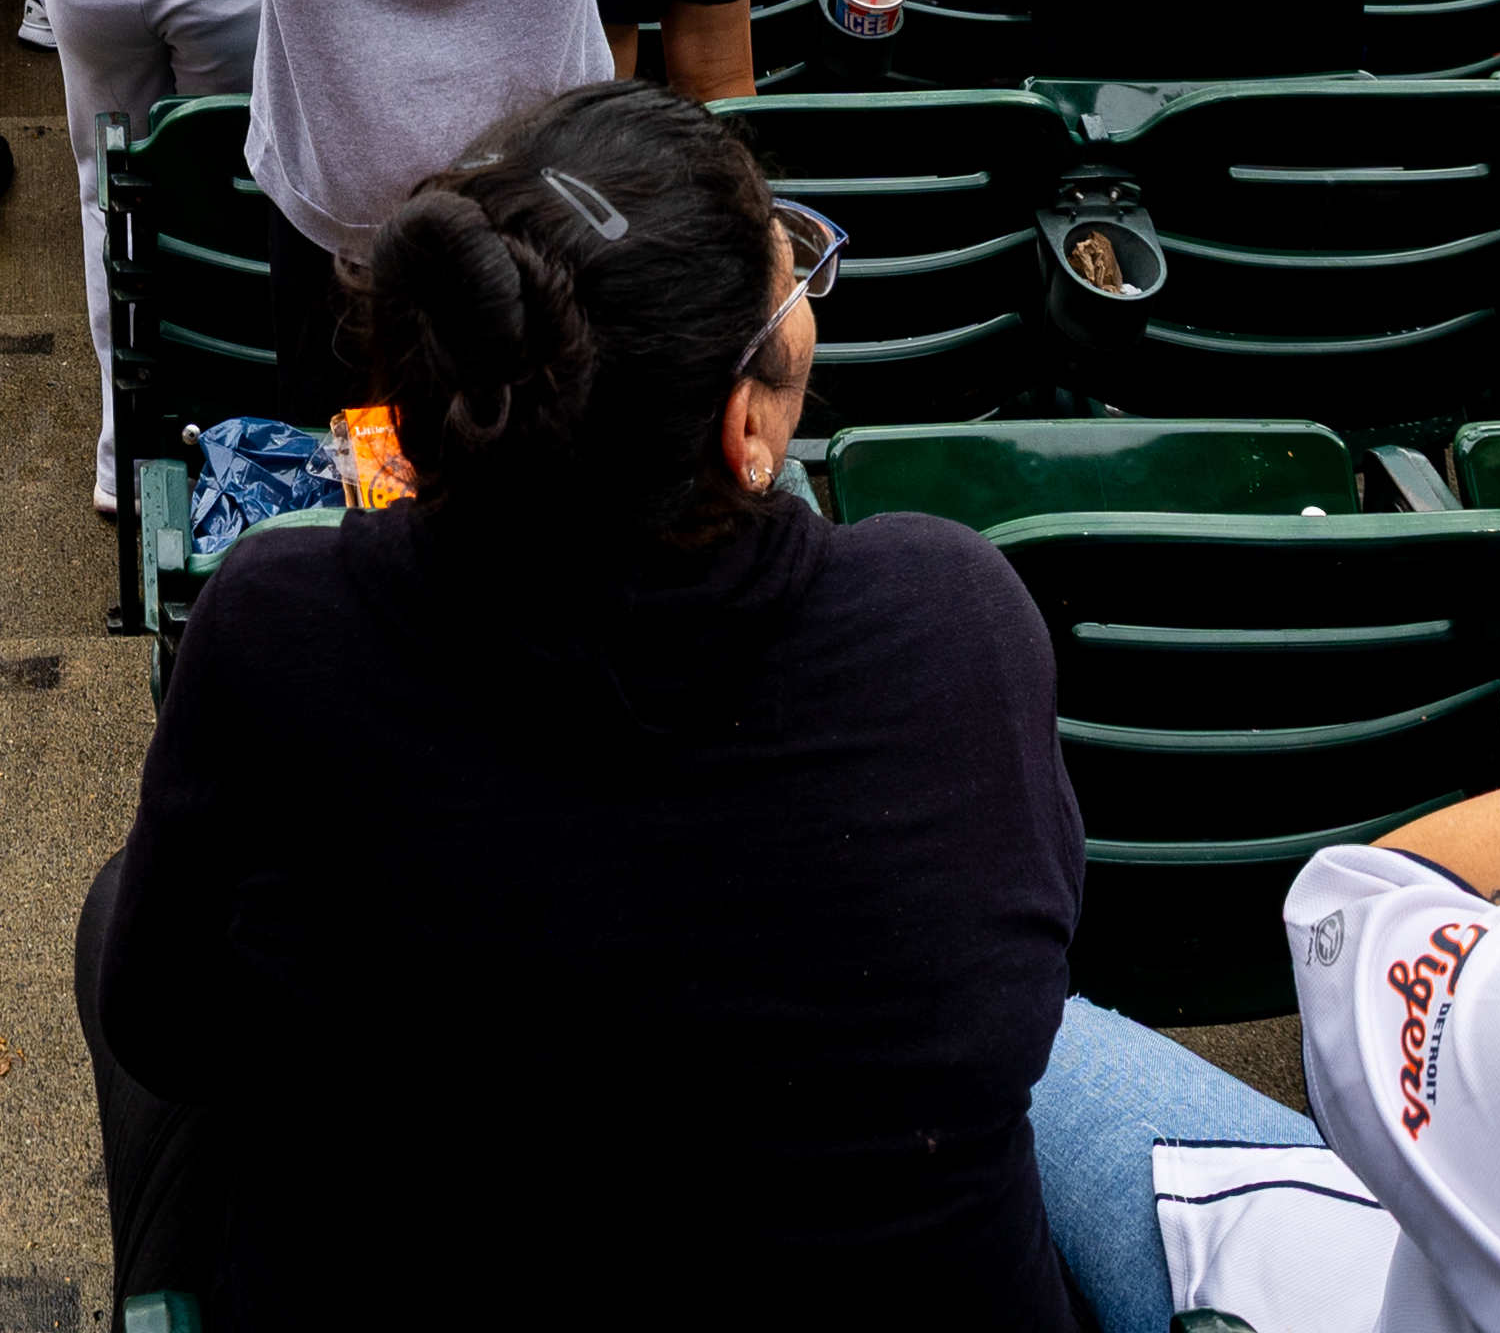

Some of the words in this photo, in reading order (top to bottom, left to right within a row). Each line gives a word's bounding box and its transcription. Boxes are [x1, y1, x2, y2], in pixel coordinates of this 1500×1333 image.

[844, 8, 889, 35] ICEE
[1388, 924, 1489, 1141] Tigers
[1426, 1002, 1452, 1105] DETROIT
